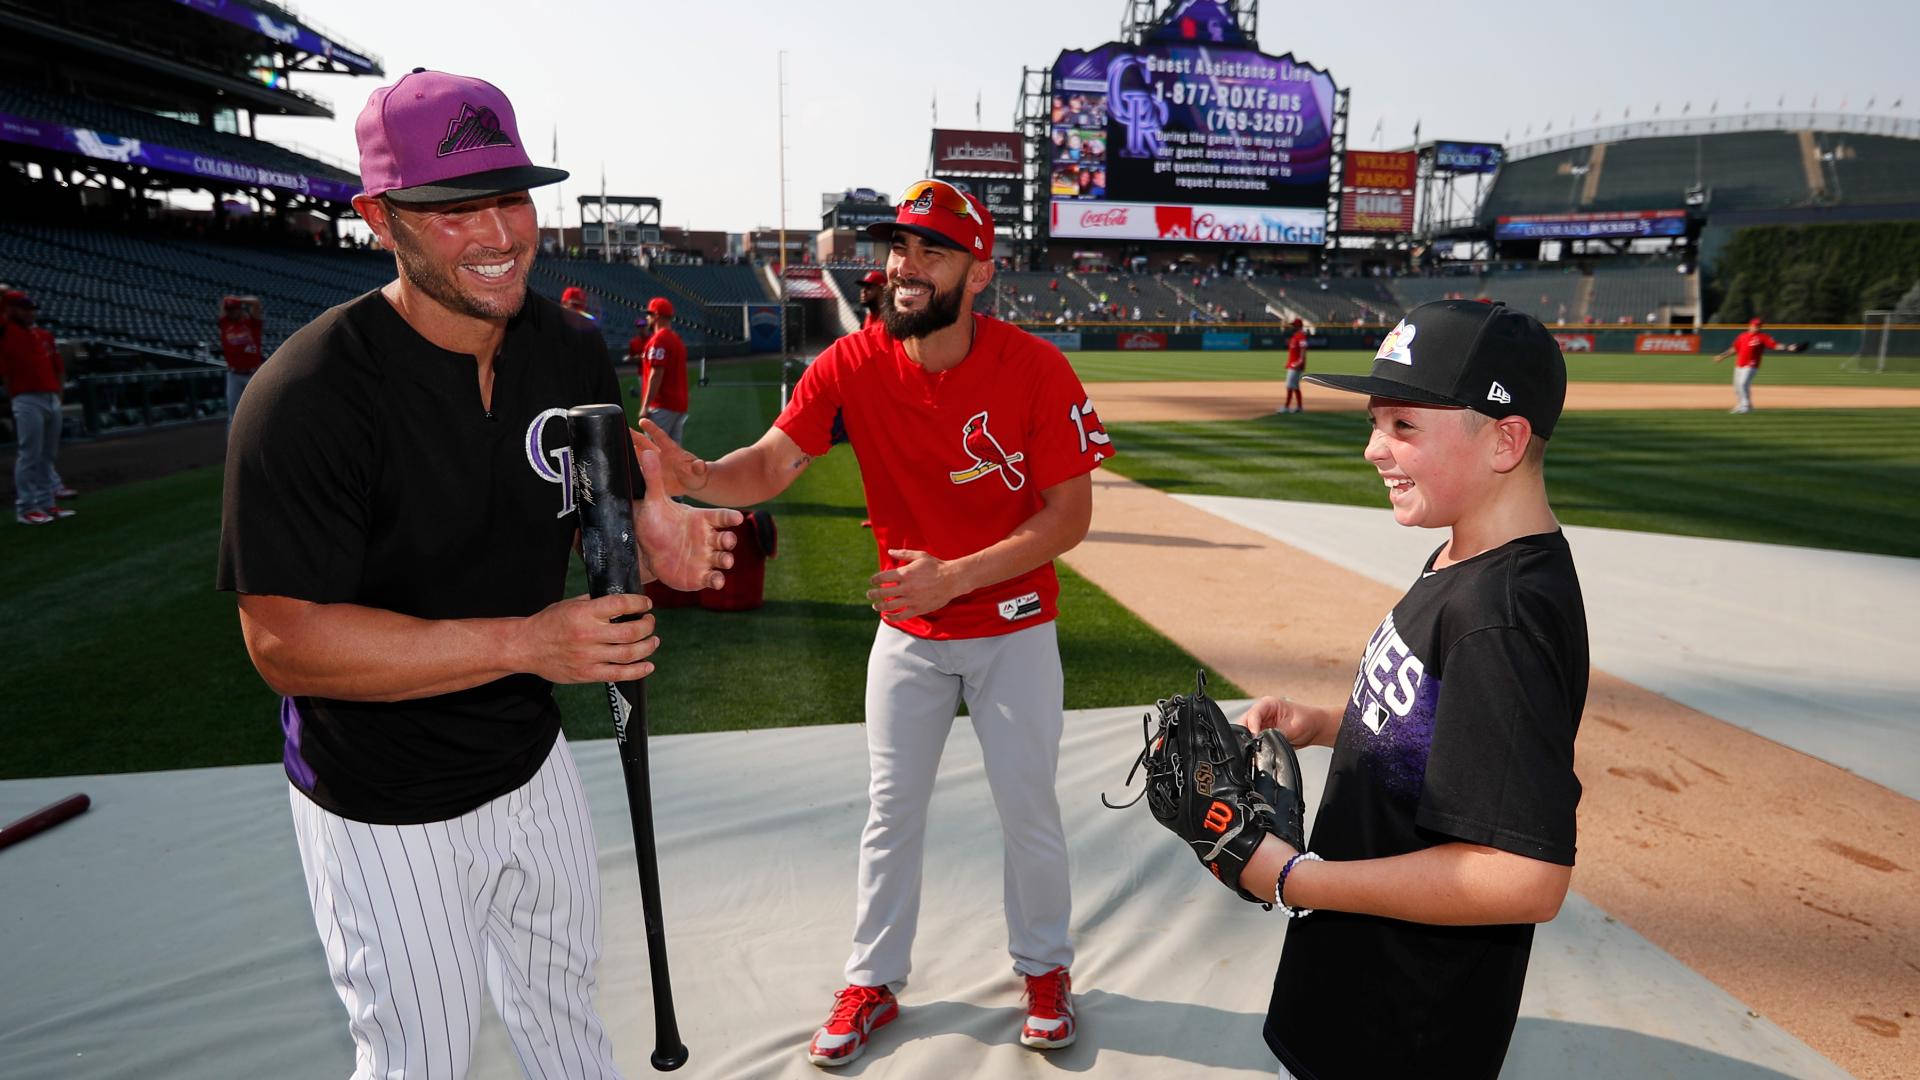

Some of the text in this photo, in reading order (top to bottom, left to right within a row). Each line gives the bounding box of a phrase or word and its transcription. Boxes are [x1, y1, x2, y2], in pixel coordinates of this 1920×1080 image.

[1146, 55, 1313, 82] Guest Assistance Line
[1155, 81, 1301, 111] 1-877-ROXFans
[1207, 110, 1303, 135] (769-3267)
[1157, 131, 1293, 149] During the game you may call
[947, 141, 1014, 160] uchealth
[1175, 147, 1204, 159] guest
[1205, 149, 1257, 161] assistance
[1259, 150, 1277, 162] line
[1279, 151, 1290, 162] to
[1154, 160, 1291, 177] get questions answered or to
[1355, 154, 1408, 169] WELLS
[193, 156, 257, 183] COLORADO
[257, 167, 298, 190] ROCKIES
[1355, 172, 1407, 186] FARGO
[1175, 177, 1213, 189] request
[1192, 213, 1325, 244] Coors LIGHT
[1641, 338, 1693, 351] STIHL
